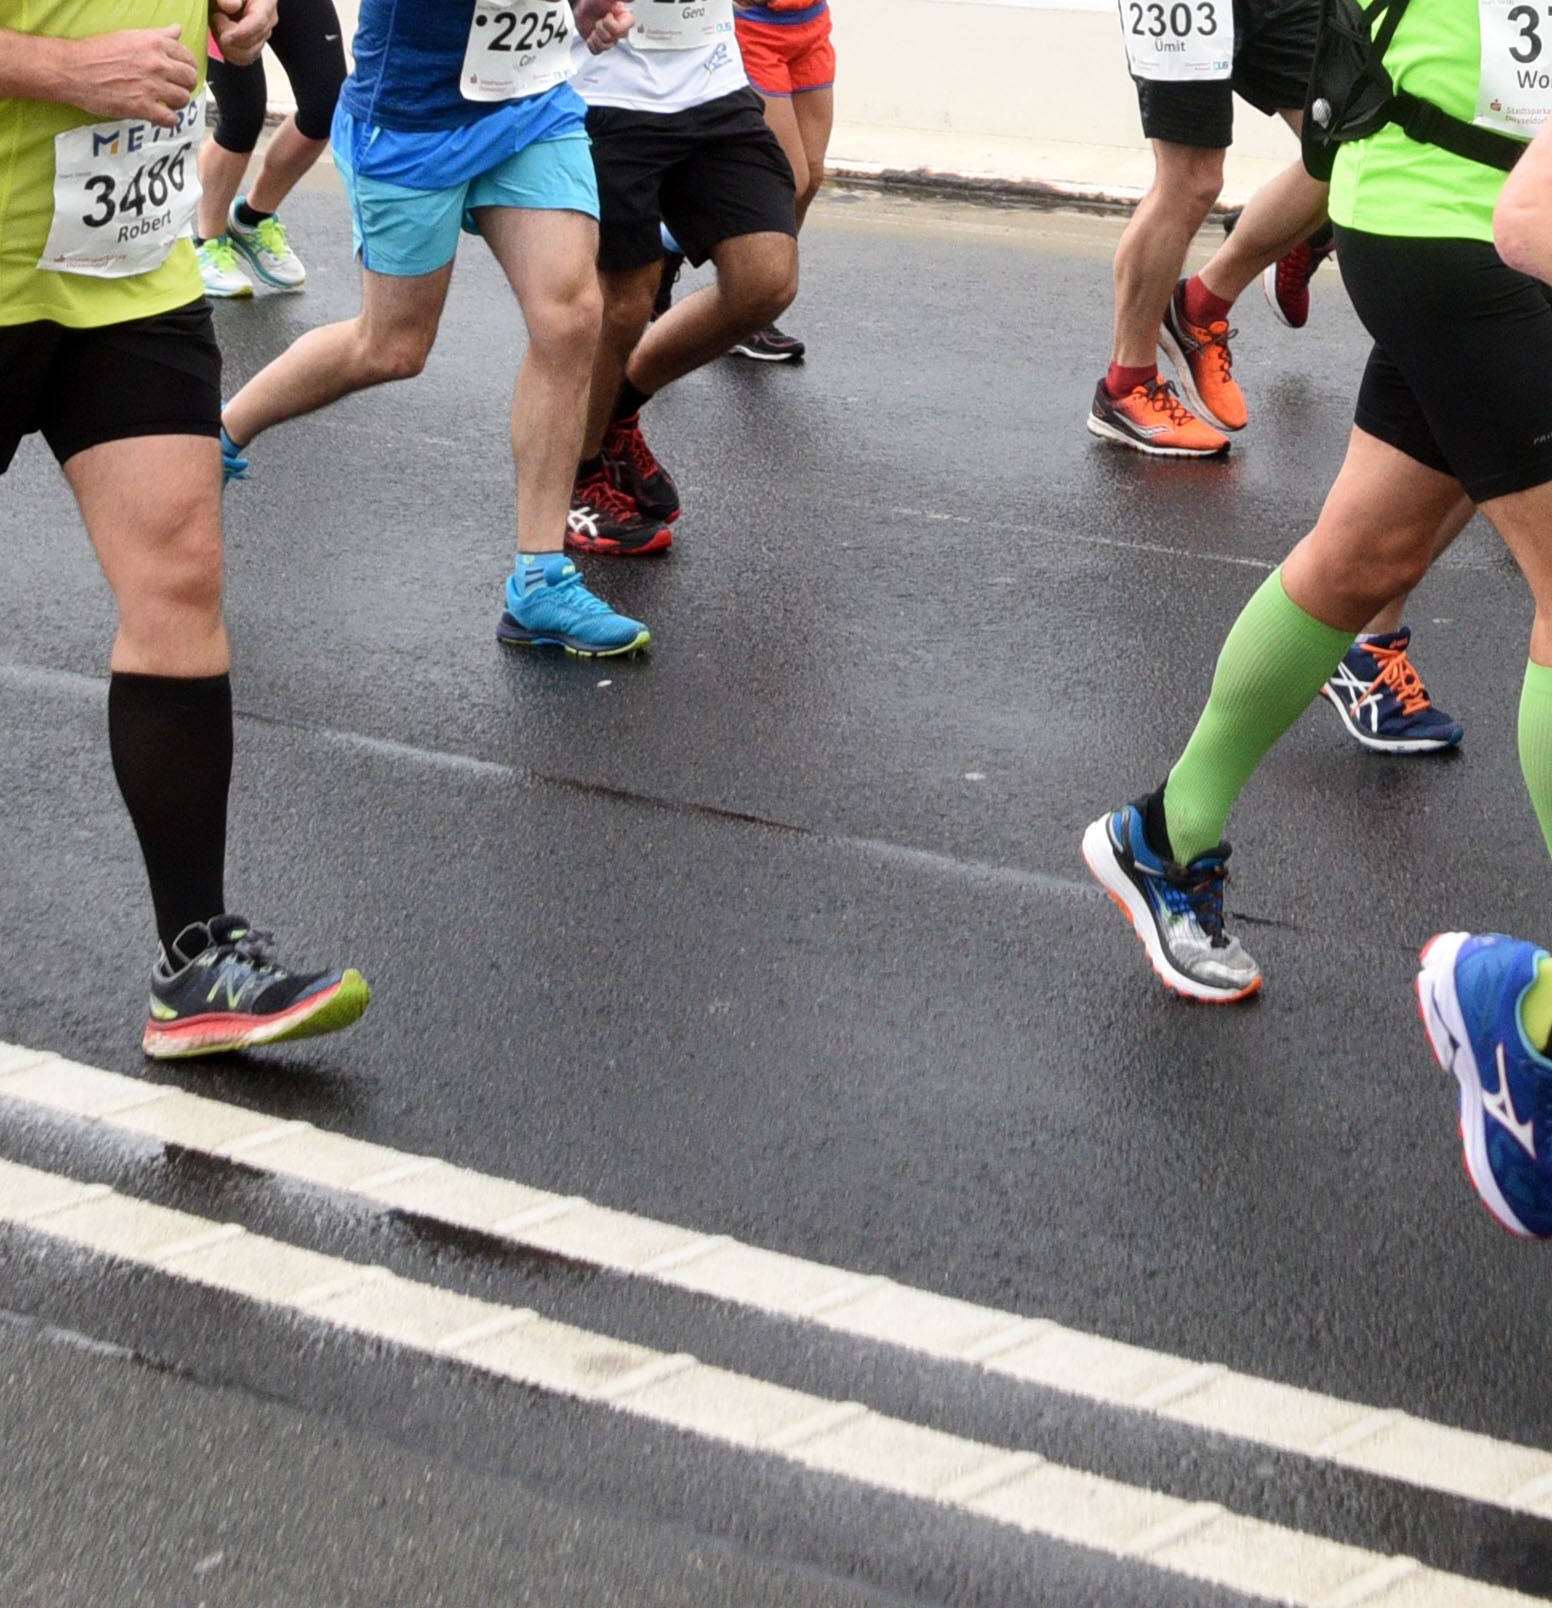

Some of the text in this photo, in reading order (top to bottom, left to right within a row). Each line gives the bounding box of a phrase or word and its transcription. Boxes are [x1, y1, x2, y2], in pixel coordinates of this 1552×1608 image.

[681, 6, 706, 20] Gero
[1129, 1, 1217, 38] 2303
[487, 10, 568, 52] 2254
[1154, 37, 1186, 52] Ümit
[82, 141, 193, 228] 3486
[117, 210, 172, 244] Robert
